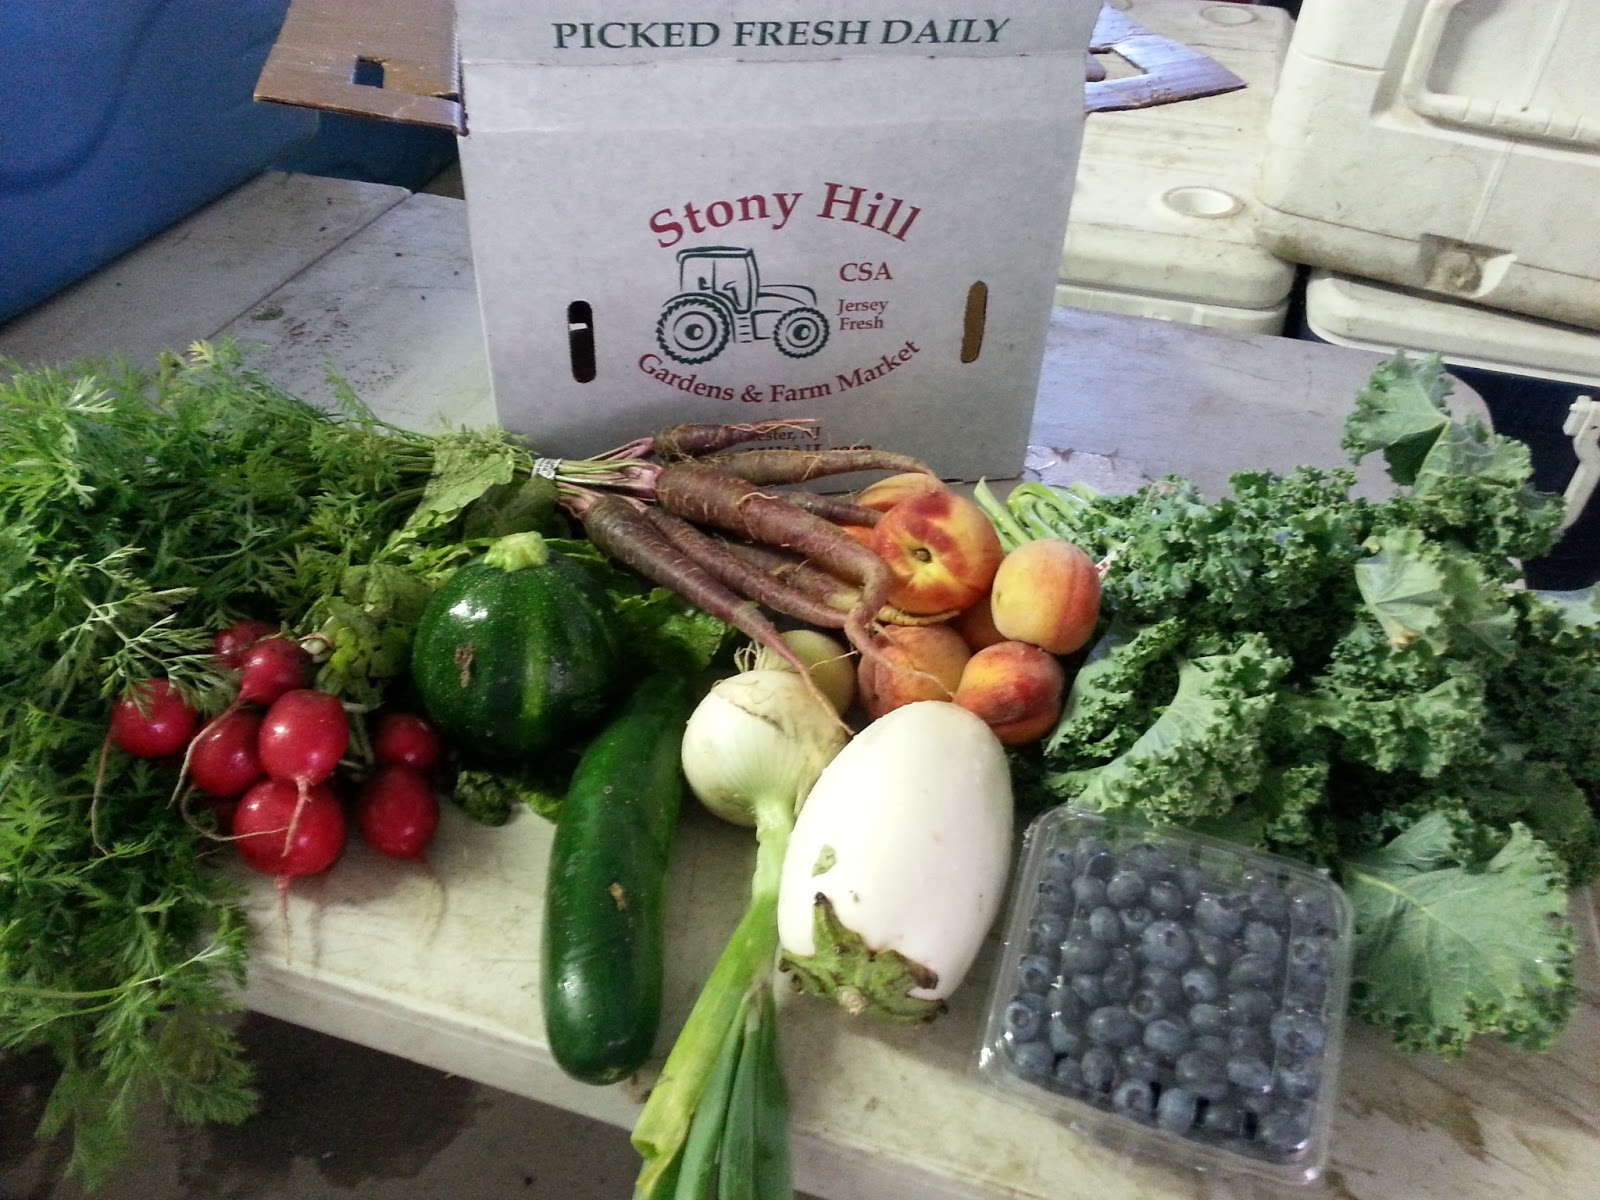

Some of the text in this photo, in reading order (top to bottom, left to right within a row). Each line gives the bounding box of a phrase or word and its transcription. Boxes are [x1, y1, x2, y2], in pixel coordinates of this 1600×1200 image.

[552, 18, 1011, 49] PICKED FRESH DAILY
[649, 181, 922, 248] Stony Hill
[839, 261, 893, 282] CSA
[837, 299, 889, 316] Jersey
[839, 316, 884, 331] Fresh
[638, 339, 921, 404] Gardens & Farm Market
